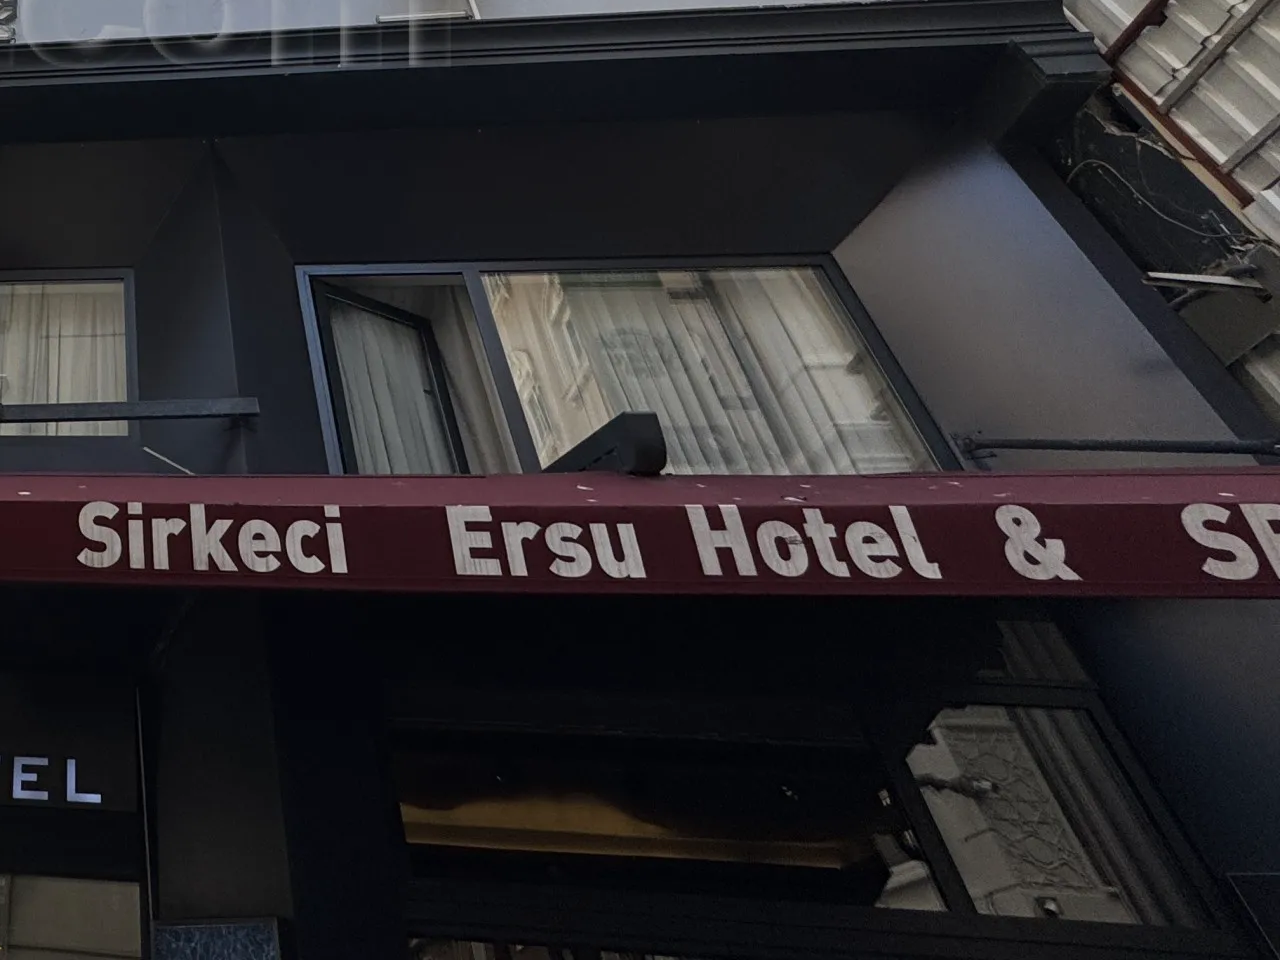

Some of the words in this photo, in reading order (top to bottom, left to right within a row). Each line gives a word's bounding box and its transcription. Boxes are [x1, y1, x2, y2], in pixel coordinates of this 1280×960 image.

[76, 500, 348, 574] Sirkeci
[445, 504, 648, 579] Ersu
[683, 503, 944, 580] Hotel
[995, 504, 1084, 581] &
